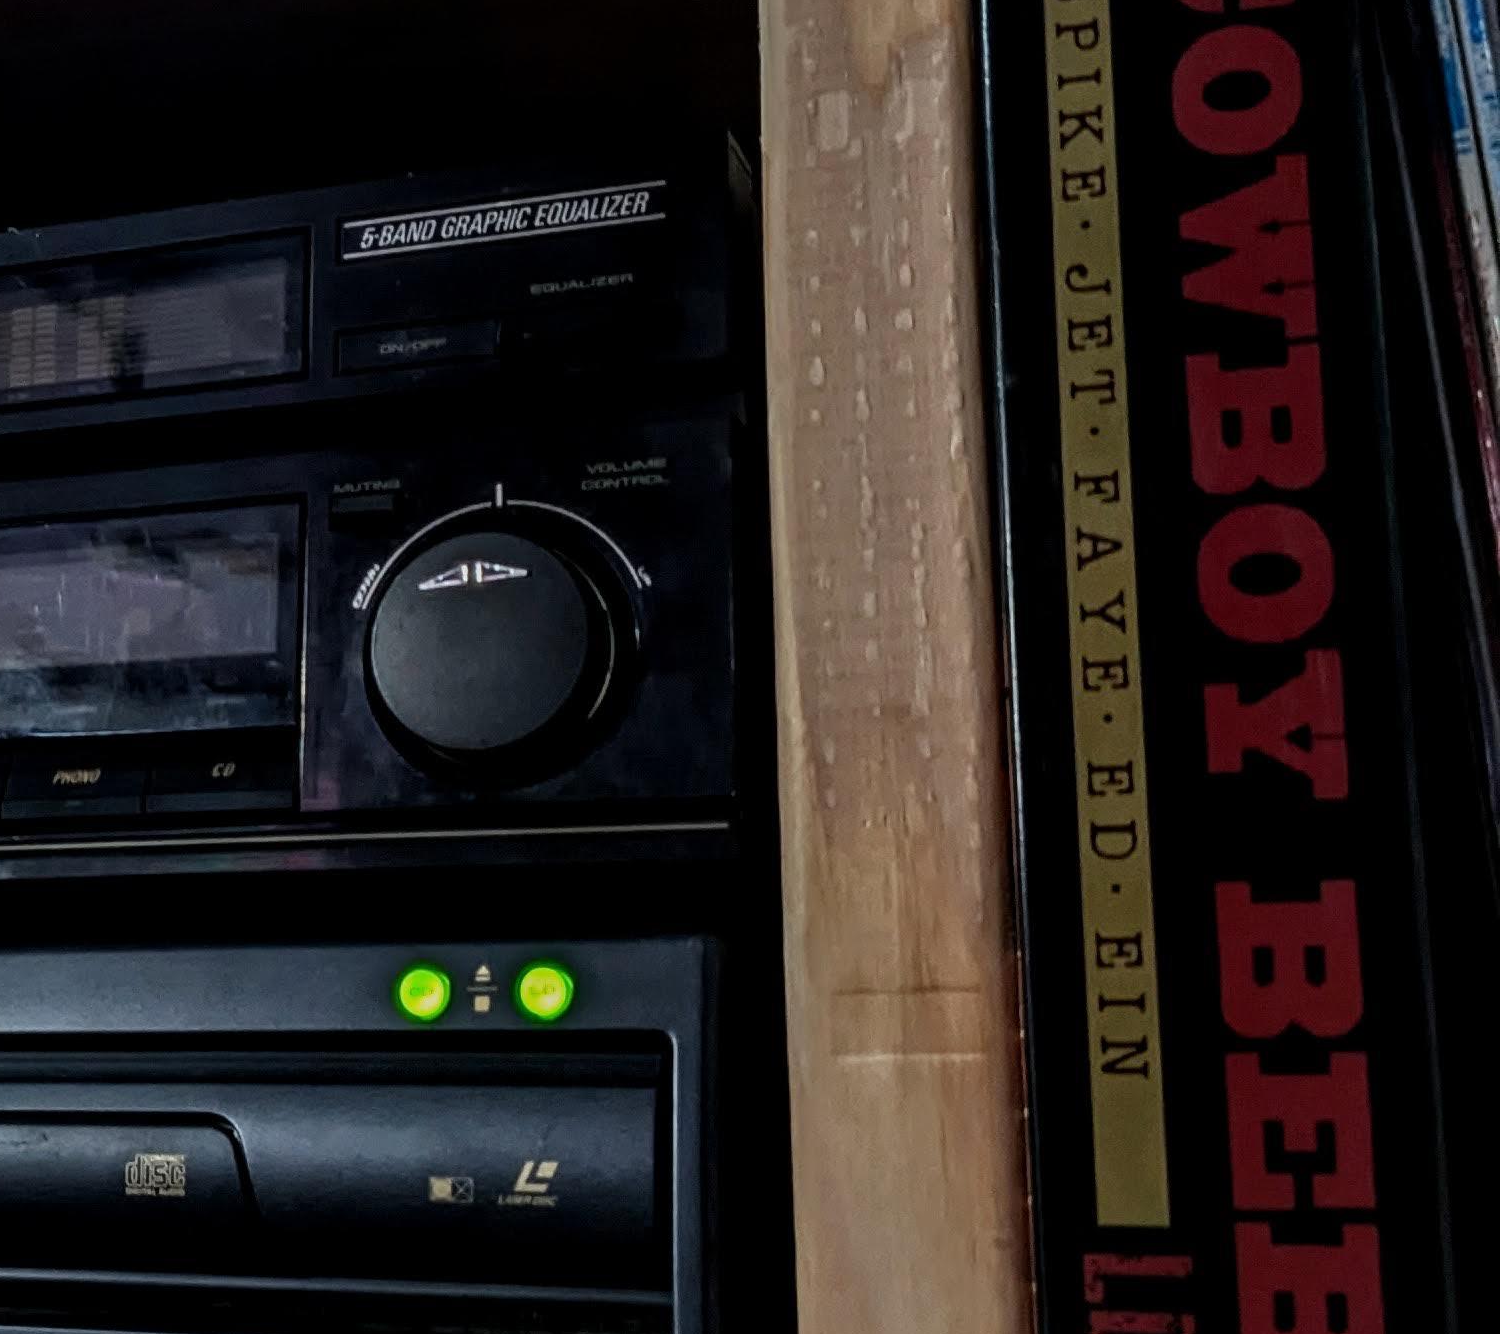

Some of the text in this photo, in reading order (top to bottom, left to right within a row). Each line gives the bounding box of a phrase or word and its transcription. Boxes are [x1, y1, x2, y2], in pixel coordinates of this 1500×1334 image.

[358, 189, 651, 251] 5-BAND GRAPHIC EQUALIZER
[529, 273, 635, 296] EQUALIZER
[585, 457, 668, 475] VOLUME
[333, 478, 400, 494] MUTING
[581, 474, 669, 492] CONTROL
[51, 768, 101, 786] PHONO
[210, 762, 236, 779] CD
[1094, 930, 1150, 1082] EIN
